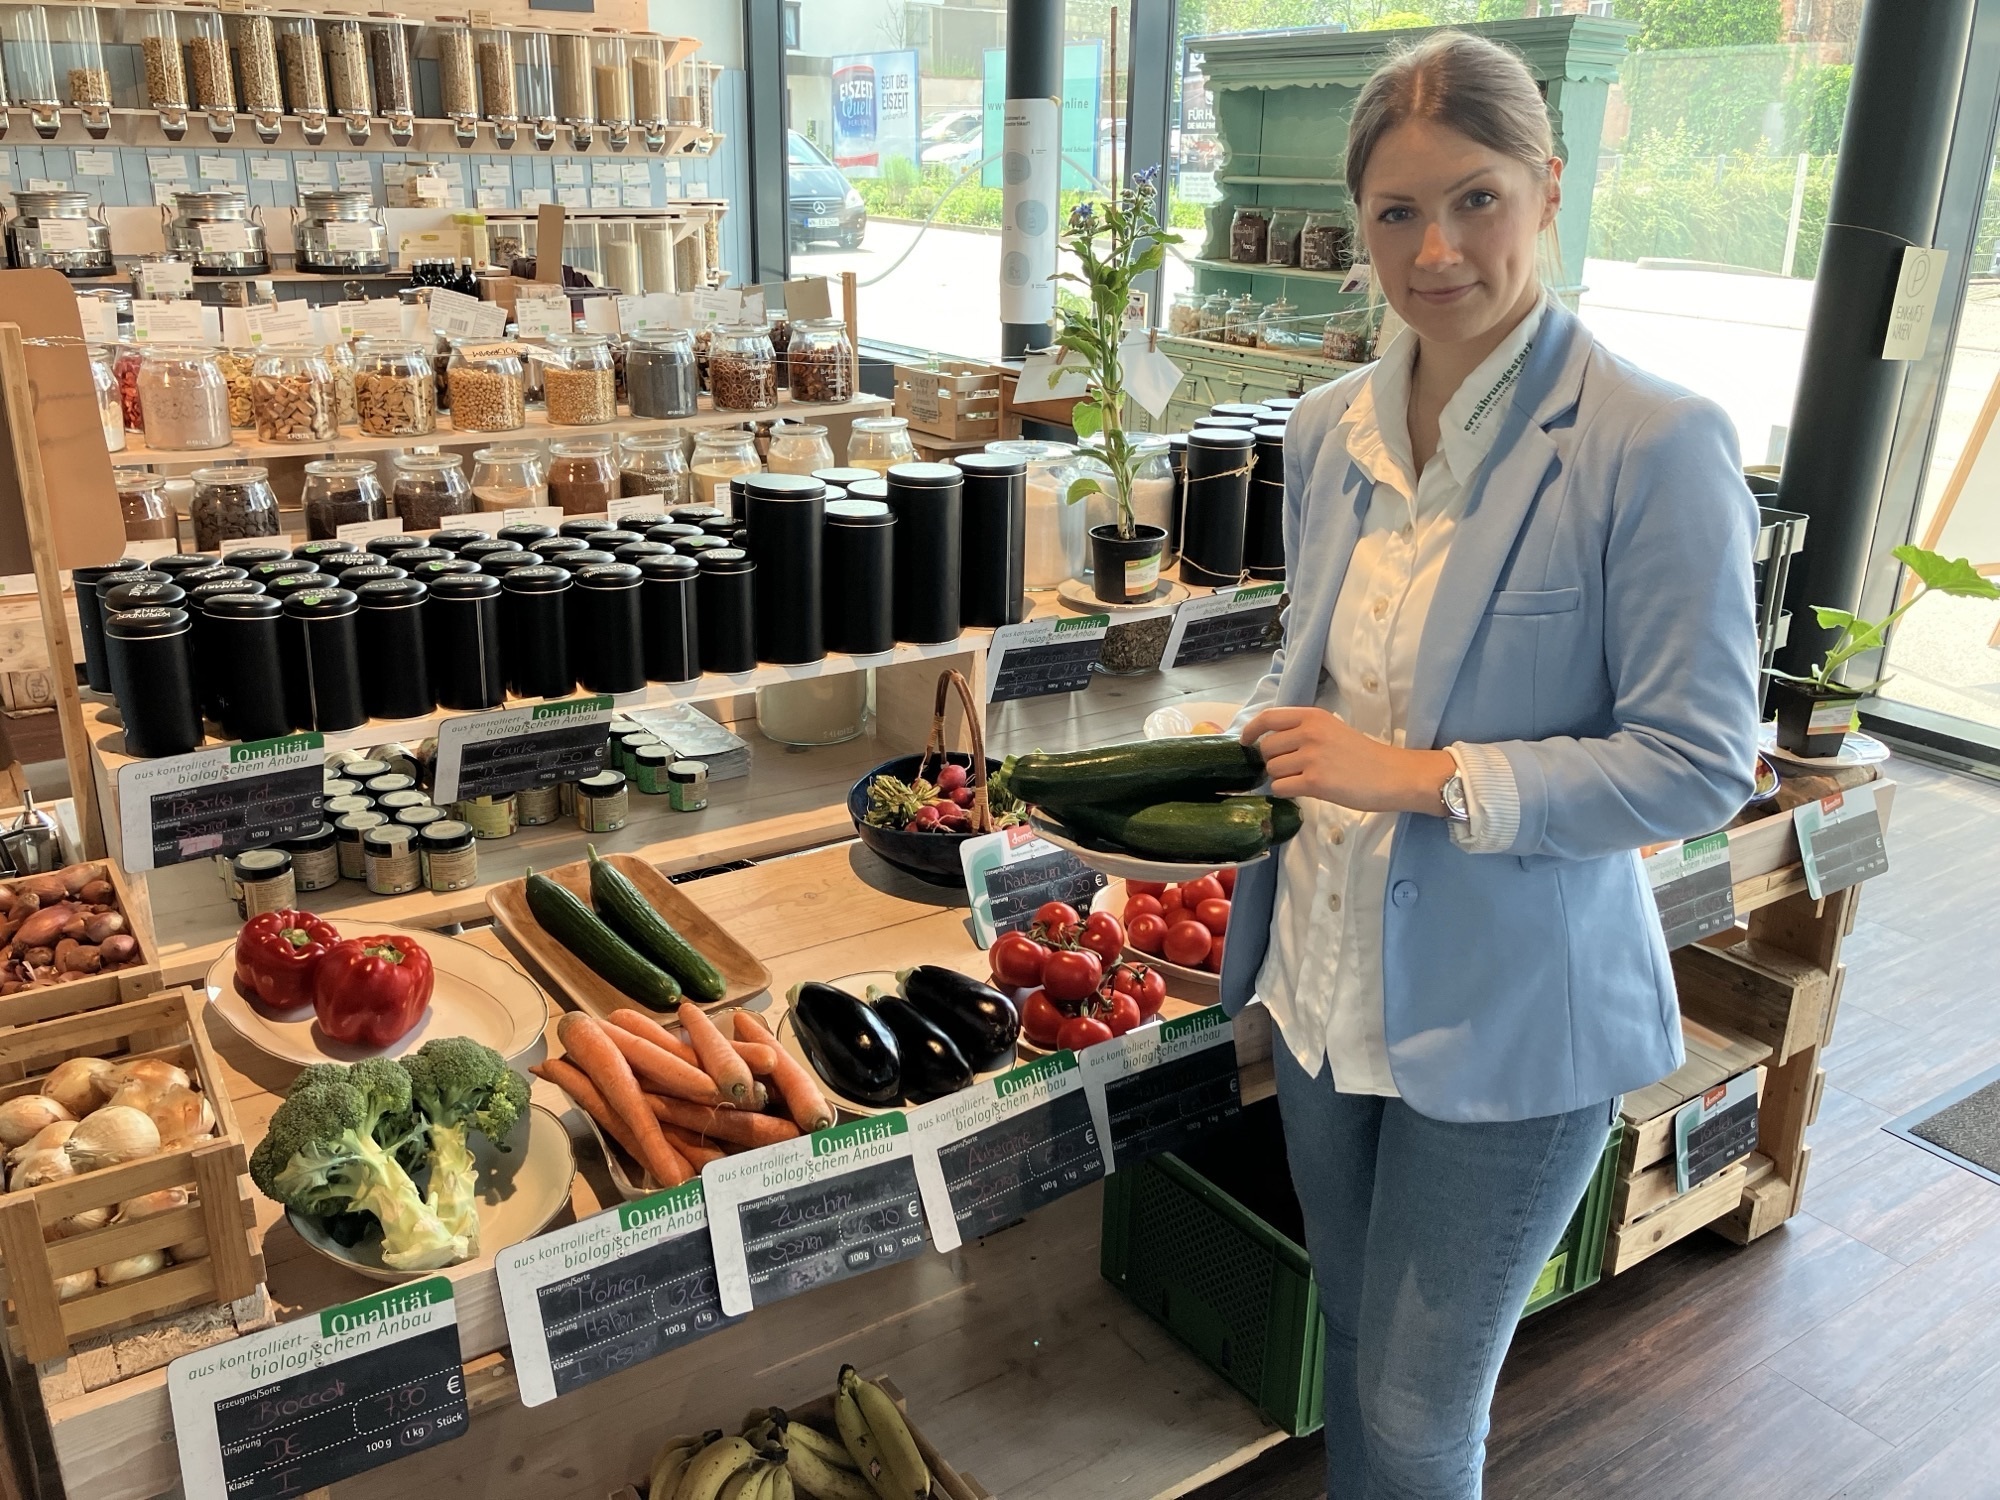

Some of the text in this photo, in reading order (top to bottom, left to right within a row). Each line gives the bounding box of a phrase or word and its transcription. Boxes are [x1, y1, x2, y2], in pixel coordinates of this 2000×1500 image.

[840, 80, 873, 101] EISZEIT
[882, 74, 908, 89] SEIT DER
[842, 96, 872, 118] Quell
[882, 93, 908, 110] EISZEIT
[1188, 108, 1204, 120] FÜR
[1058, 620, 1101, 632] Qualität
[1087, 662, 1095, 671] €
[538, 701, 602, 720] Qualität
[451, 716, 525, 733] aus kontrolliert-
[486, 713, 598, 736] biologischem Anbau
[236, 739, 312, 763] Qualität
[492, 742, 537, 758] Gurke
[594, 748, 603, 757] €
[134, 759, 223, 781] aus kontrolliert-
[178, 754, 309, 785] biologischem Anbau
[164, 795, 234, 820] Paprika
[311, 796, 322, 809] €
[301, 819, 320, 828] Stück
[1685, 840, 1722, 860] Qualität
[1095, 874, 1102, 886] €
[1165, 1013, 1221, 1042] Qualität
[1090, 1040, 1154, 1067] aus kontrolliert-
[1122, 1028, 1221, 1070] biologischem Anbau
[1001, 1059, 1065, 1097] Qualität
[1229, 1078, 1238, 1092] €
[917, 1094, 990, 1132] aus kontrolliert-
[955, 1077, 1067, 1132] biologischem Anbau
[1750, 1118, 1756, 1130] €
[818, 1121, 894, 1157] Qualität
[1085, 1129, 1096, 1145] €
[718, 1152, 805, 1184] aus kontrolliert-
[762, 1140, 894, 1188] biologischem Anbau
[1083, 1159, 1100, 1173] Stück
[628, 1188, 703, 1230] Qualitä
[771, 1192, 852, 1228] Zucchini
[907, 1200, 919, 1218] €
[956, 1209, 973, 1222] Klasse
[513, 1226, 612, 1269] aus kontrolliert-
[564, 1226, 662, 1269] biologischem
[901, 1234, 922, 1247] Stück
[750, 1273, 770, 1285] Klasse
[329, 1289, 433, 1337] Qualität
[547, 1321, 578, 1338] Ursprung
[250, 1312, 433, 1380] biologischem Anbau
[188, 1335, 310, 1381] aus kontrolliert-
[552, 1357, 574, 1371] Klasse
[446, 1375, 462, 1395] €
[216, 1384, 281, 1412] Erzeugnis/Sorte
[365, 1441, 384, 1454] 100
[412, 1425, 425, 1439] kg
[436, 1411, 463, 1429] Stück
[222, 1437, 261, 1458] Ursprung
[228, 1477, 255, 1493] Klasse
